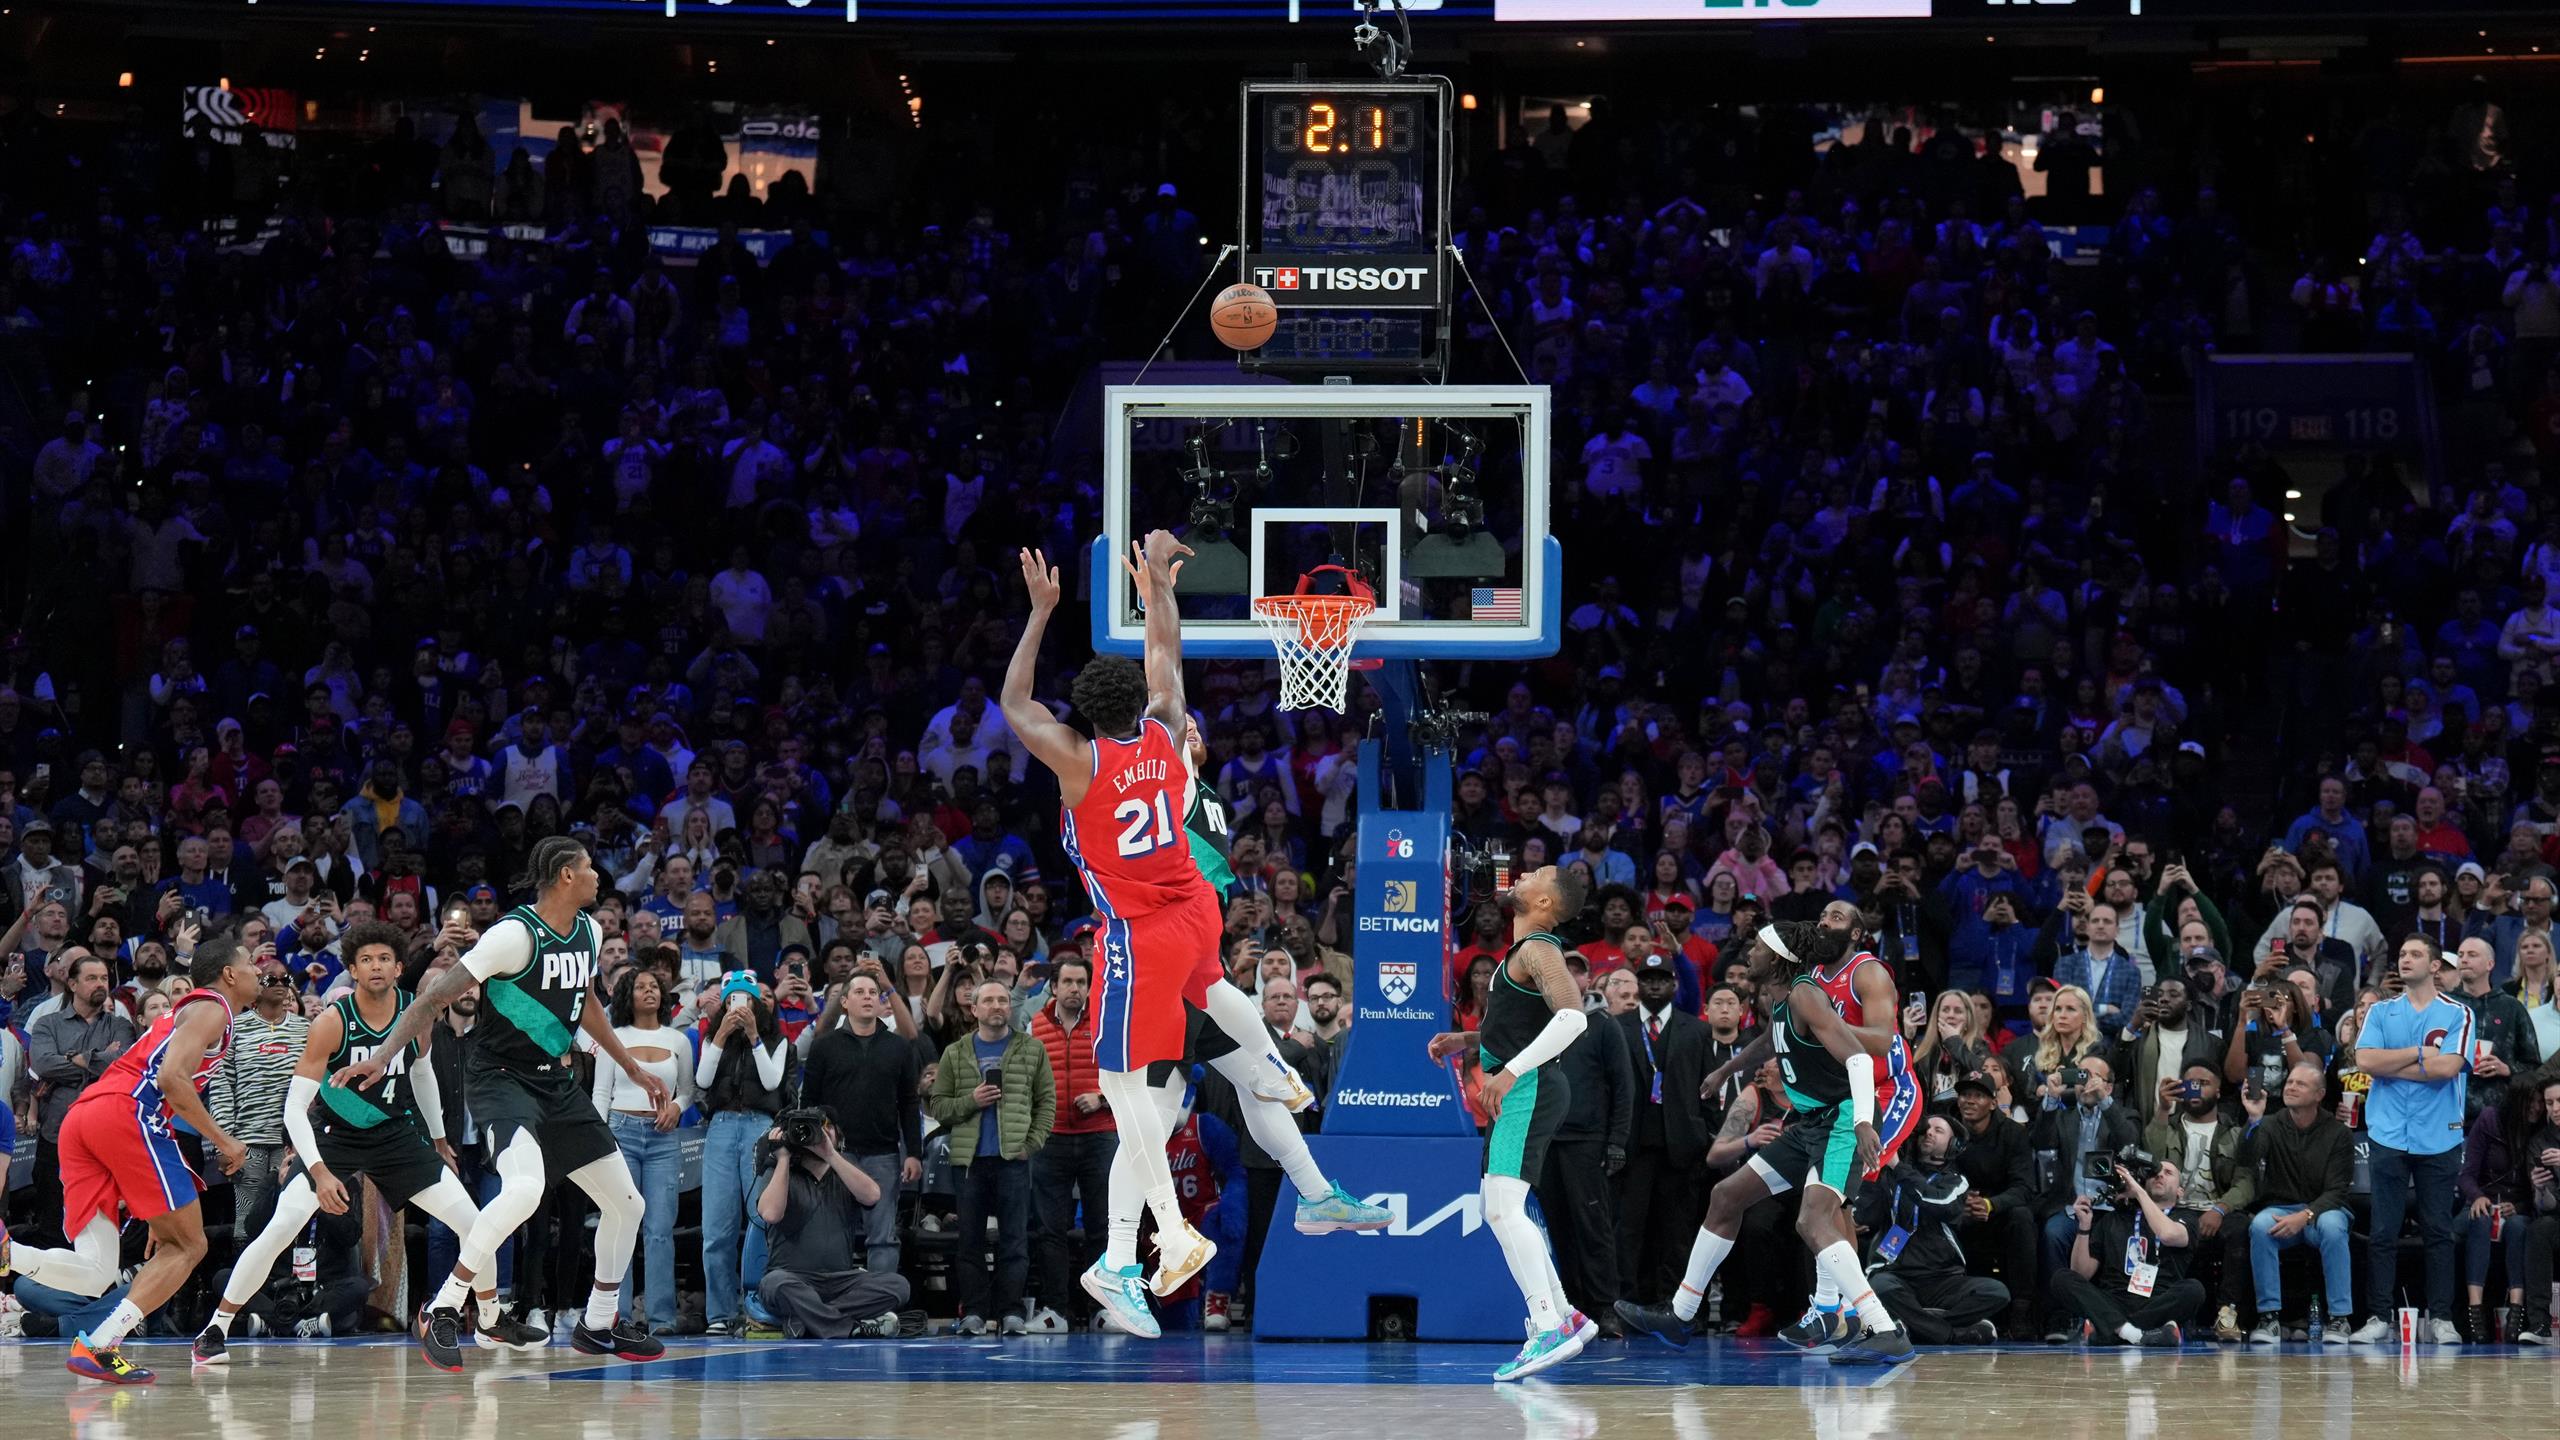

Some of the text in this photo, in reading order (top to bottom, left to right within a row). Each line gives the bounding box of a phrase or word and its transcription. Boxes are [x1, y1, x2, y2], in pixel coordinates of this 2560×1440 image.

[1306, 103, 1383, 152] 2.1
[1302, 267, 1428, 291] TISSOT
[2226, 407, 2278, 440] 119
[2344, 407, 2399, 440] 118
[1112, 759, 1168, 794] EMBIID
[1114, 788, 1177, 858] 21
[1386, 838, 1414, 859] 76
[1359, 916, 1440, 934] BETMGM
[541, 950, 590, 990] PDX
[569, 991, 585, 1022] 5
[1360, 1006, 1435, 1021] Penn Medicine
[1781, 1057, 1797, 1084] 9
[381, 1078, 397, 1105] 4
[1338, 1088, 1445, 1107] ticketmaster
[682, 1145, 699, 1154] Group
